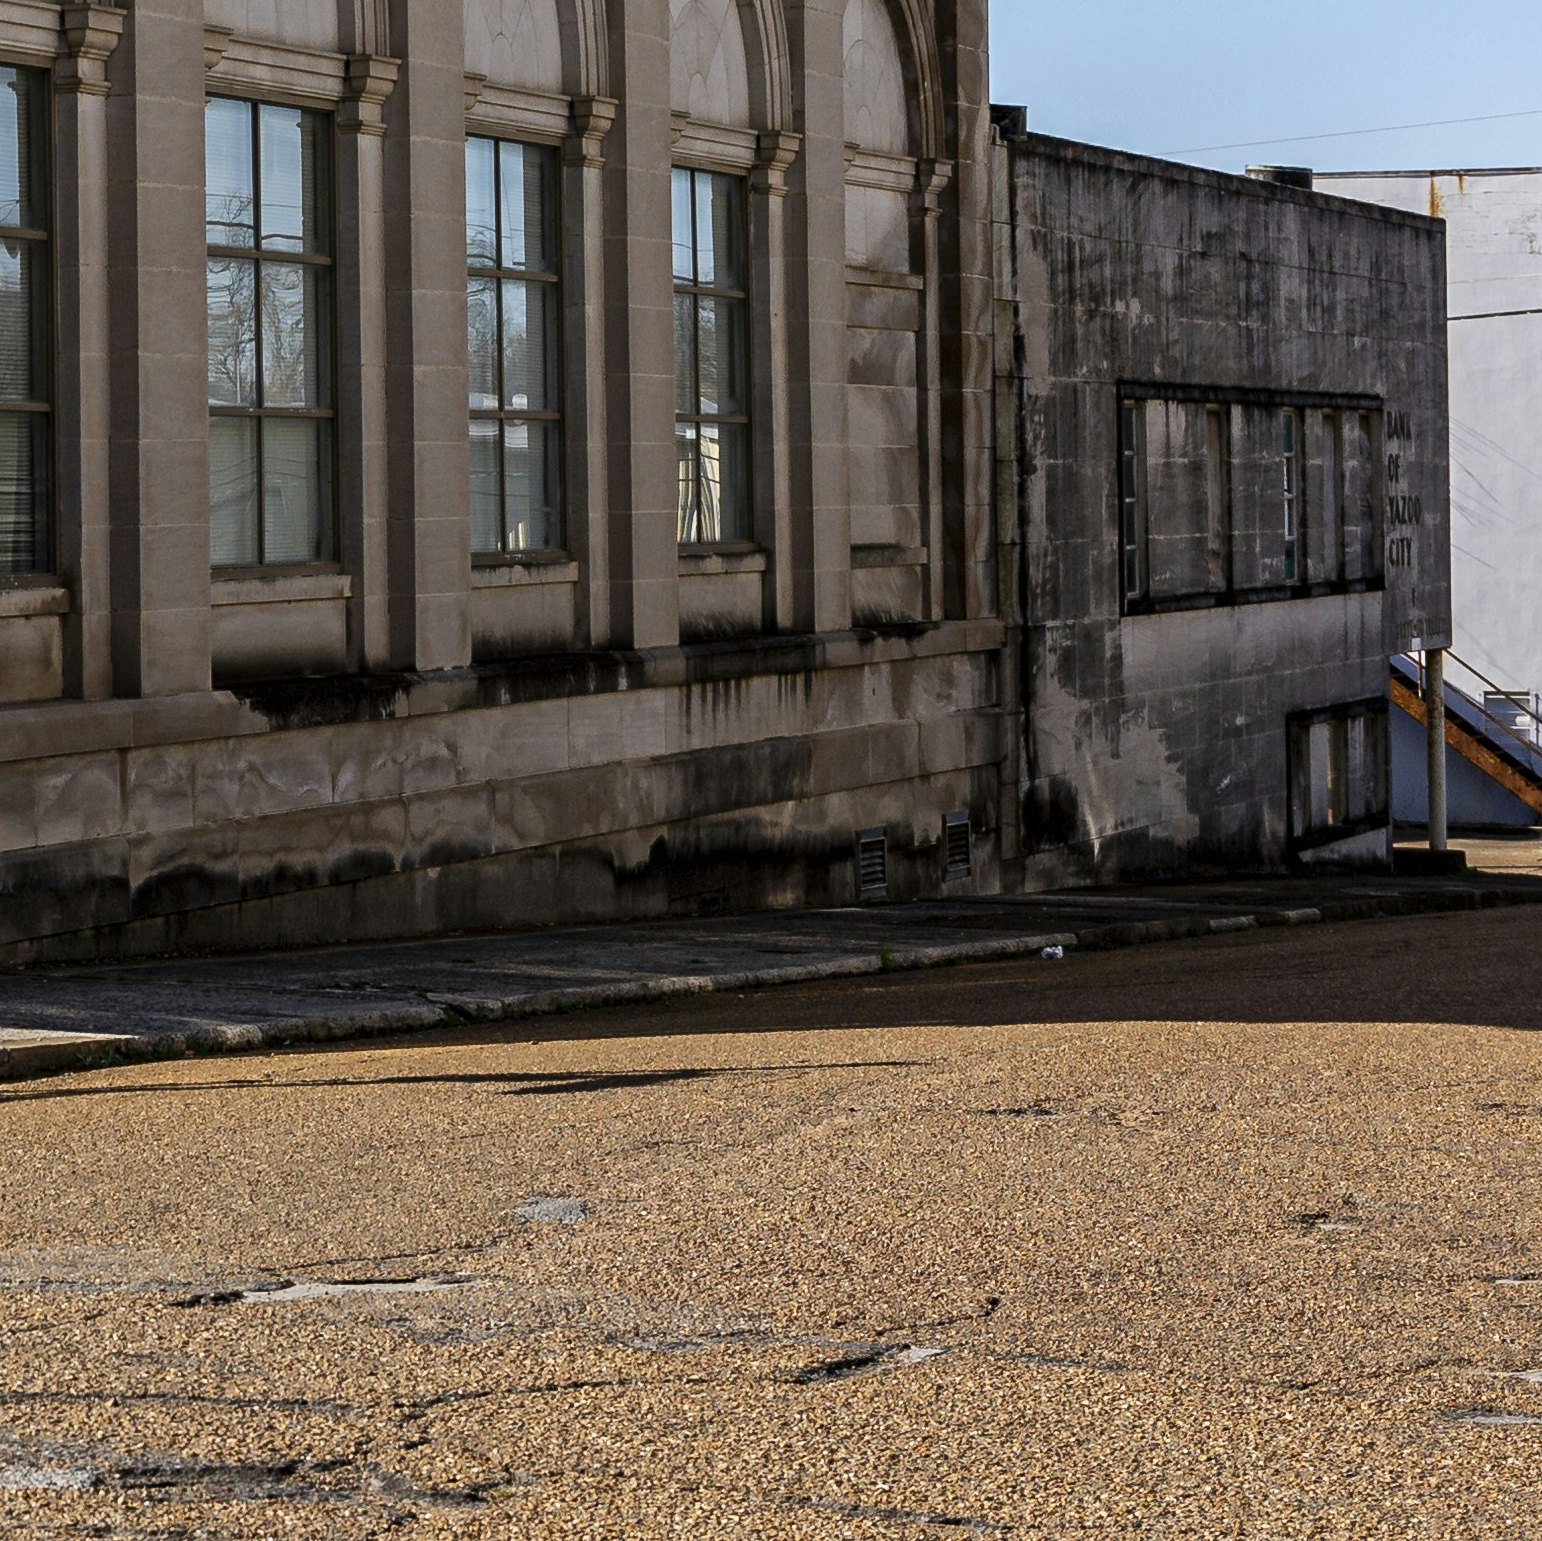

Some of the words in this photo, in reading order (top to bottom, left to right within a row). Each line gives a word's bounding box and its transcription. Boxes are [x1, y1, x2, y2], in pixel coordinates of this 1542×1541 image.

[1386, 410, 1412, 441] BANK
[1388, 453, 1400, 484] OF
[1388, 494, 1421, 526] YAZOO
[1389, 537, 1412, 567] CITY
